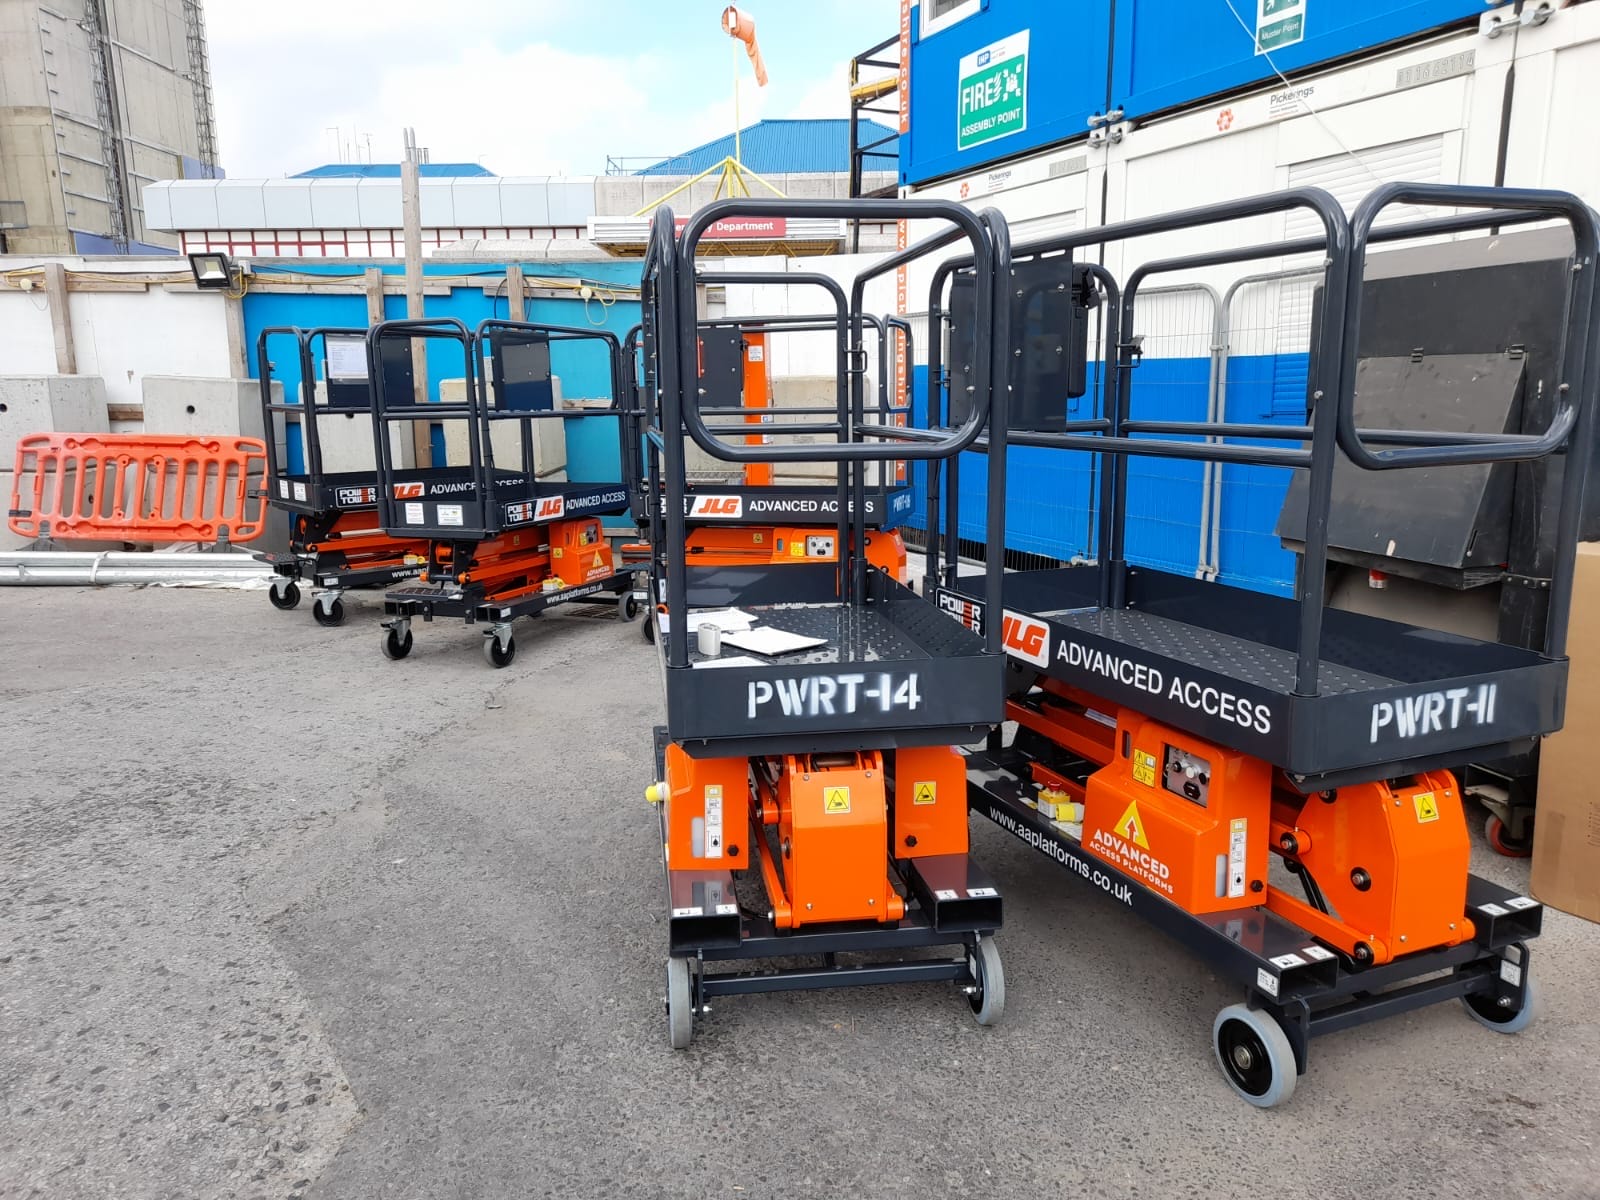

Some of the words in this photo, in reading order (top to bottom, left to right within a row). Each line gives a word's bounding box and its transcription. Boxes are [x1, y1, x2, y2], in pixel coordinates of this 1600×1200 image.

[1262, 28, 1281, 40] Muster
[1282, 22, 1300, 33] Point
[901, 0, 910, 123] shire.co.uk
[962, 77, 994, 116] FIRE
[1270, 86, 1315, 105] Pickerings
[961, 115, 997, 137] ASSEMBLY
[998, 108, 1021, 125] POINT
[716, 221, 774, 233] Department
[339, 487, 376, 497] POWER
[341, 495, 377, 505] TOWER
[566, 495, 600, 510] ADVANCED
[601, 490, 626, 504] ACCESS
[507, 502, 532, 514] POWER
[538, 498, 562, 517] JLG
[698, 498, 740, 514] JLG
[749, 500, 817, 512] ADVANCED
[820, 500, 874, 513] ACES
[509, 511, 533, 521] TOWER
[940, 594, 981, 621] POWER
[748, 673, 921, 719] PWRT-14
[1057, 639, 1163, 694] ADVANCED
[1168, 677, 1272, 734] ACCESS
[989, 804, 1133, 906] www.aaplatforms.co.uk
[1094, 829, 1170, 879] ADVANCED
[1089, 841, 1121, 864] ACCESS
[1122, 858, 1174, 894] PLATFORMS
